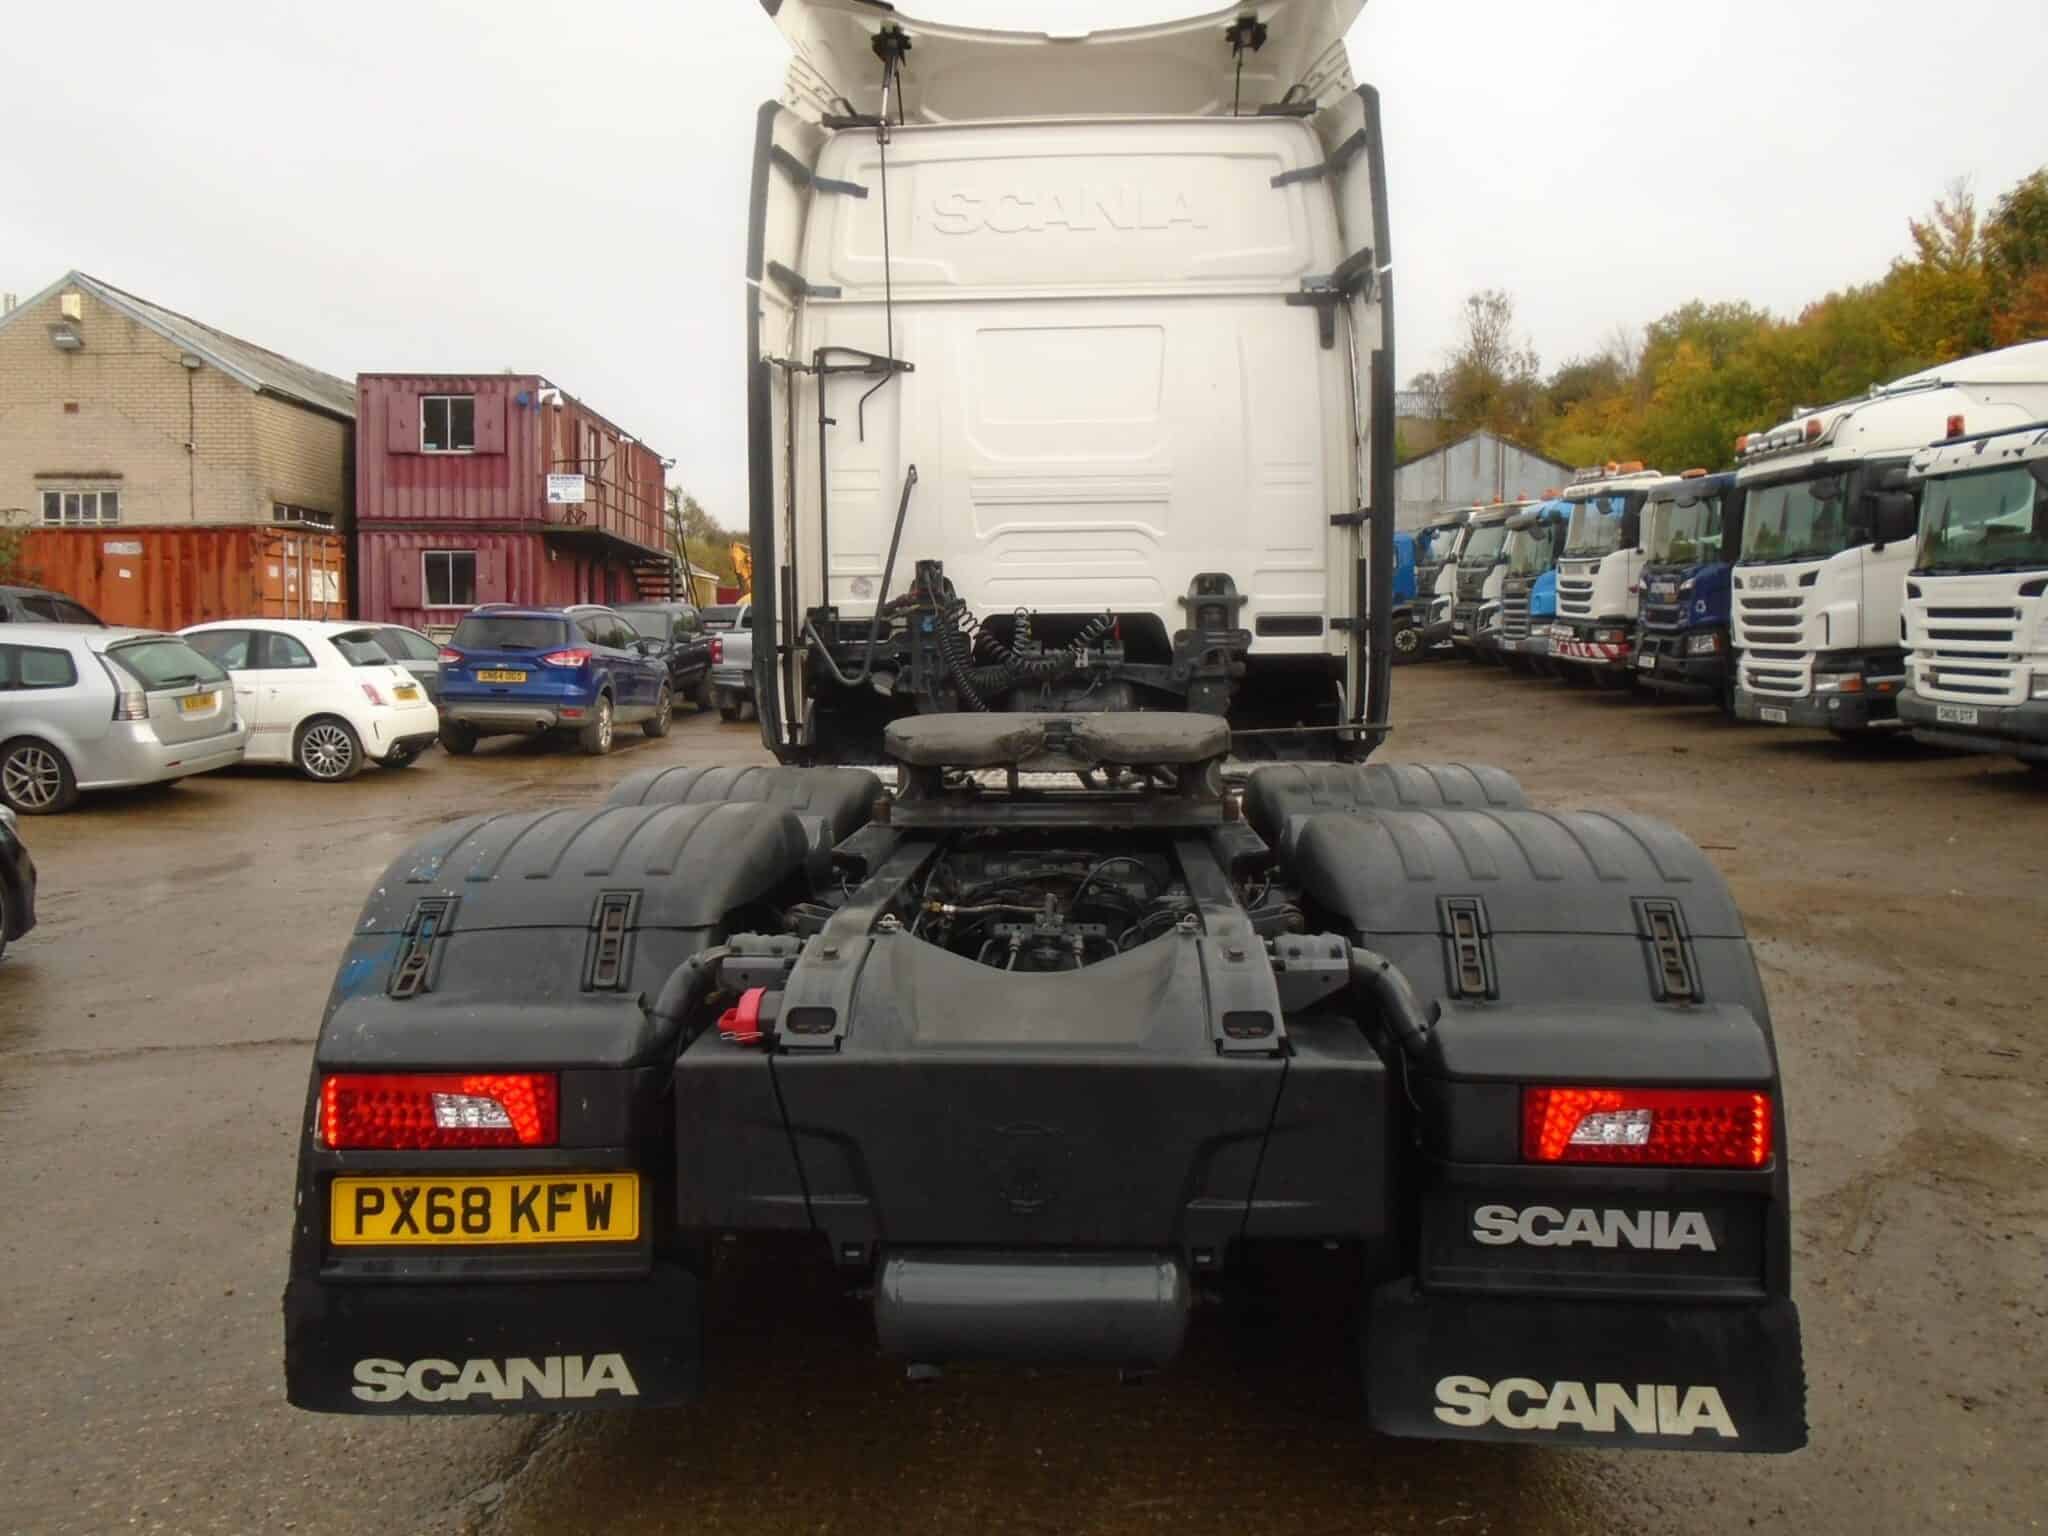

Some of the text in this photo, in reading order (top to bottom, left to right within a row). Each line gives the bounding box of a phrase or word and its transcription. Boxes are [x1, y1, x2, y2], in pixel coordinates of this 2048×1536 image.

[932, 187, 1208, 235] SCANIA
[355, 1183, 613, 1235] PX68 KFW
[1472, 1204, 1717, 1251] SCANIA
[352, 1352, 640, 1402] SCANIA
[1434, 1375, 1739, 1437] SCANIA
